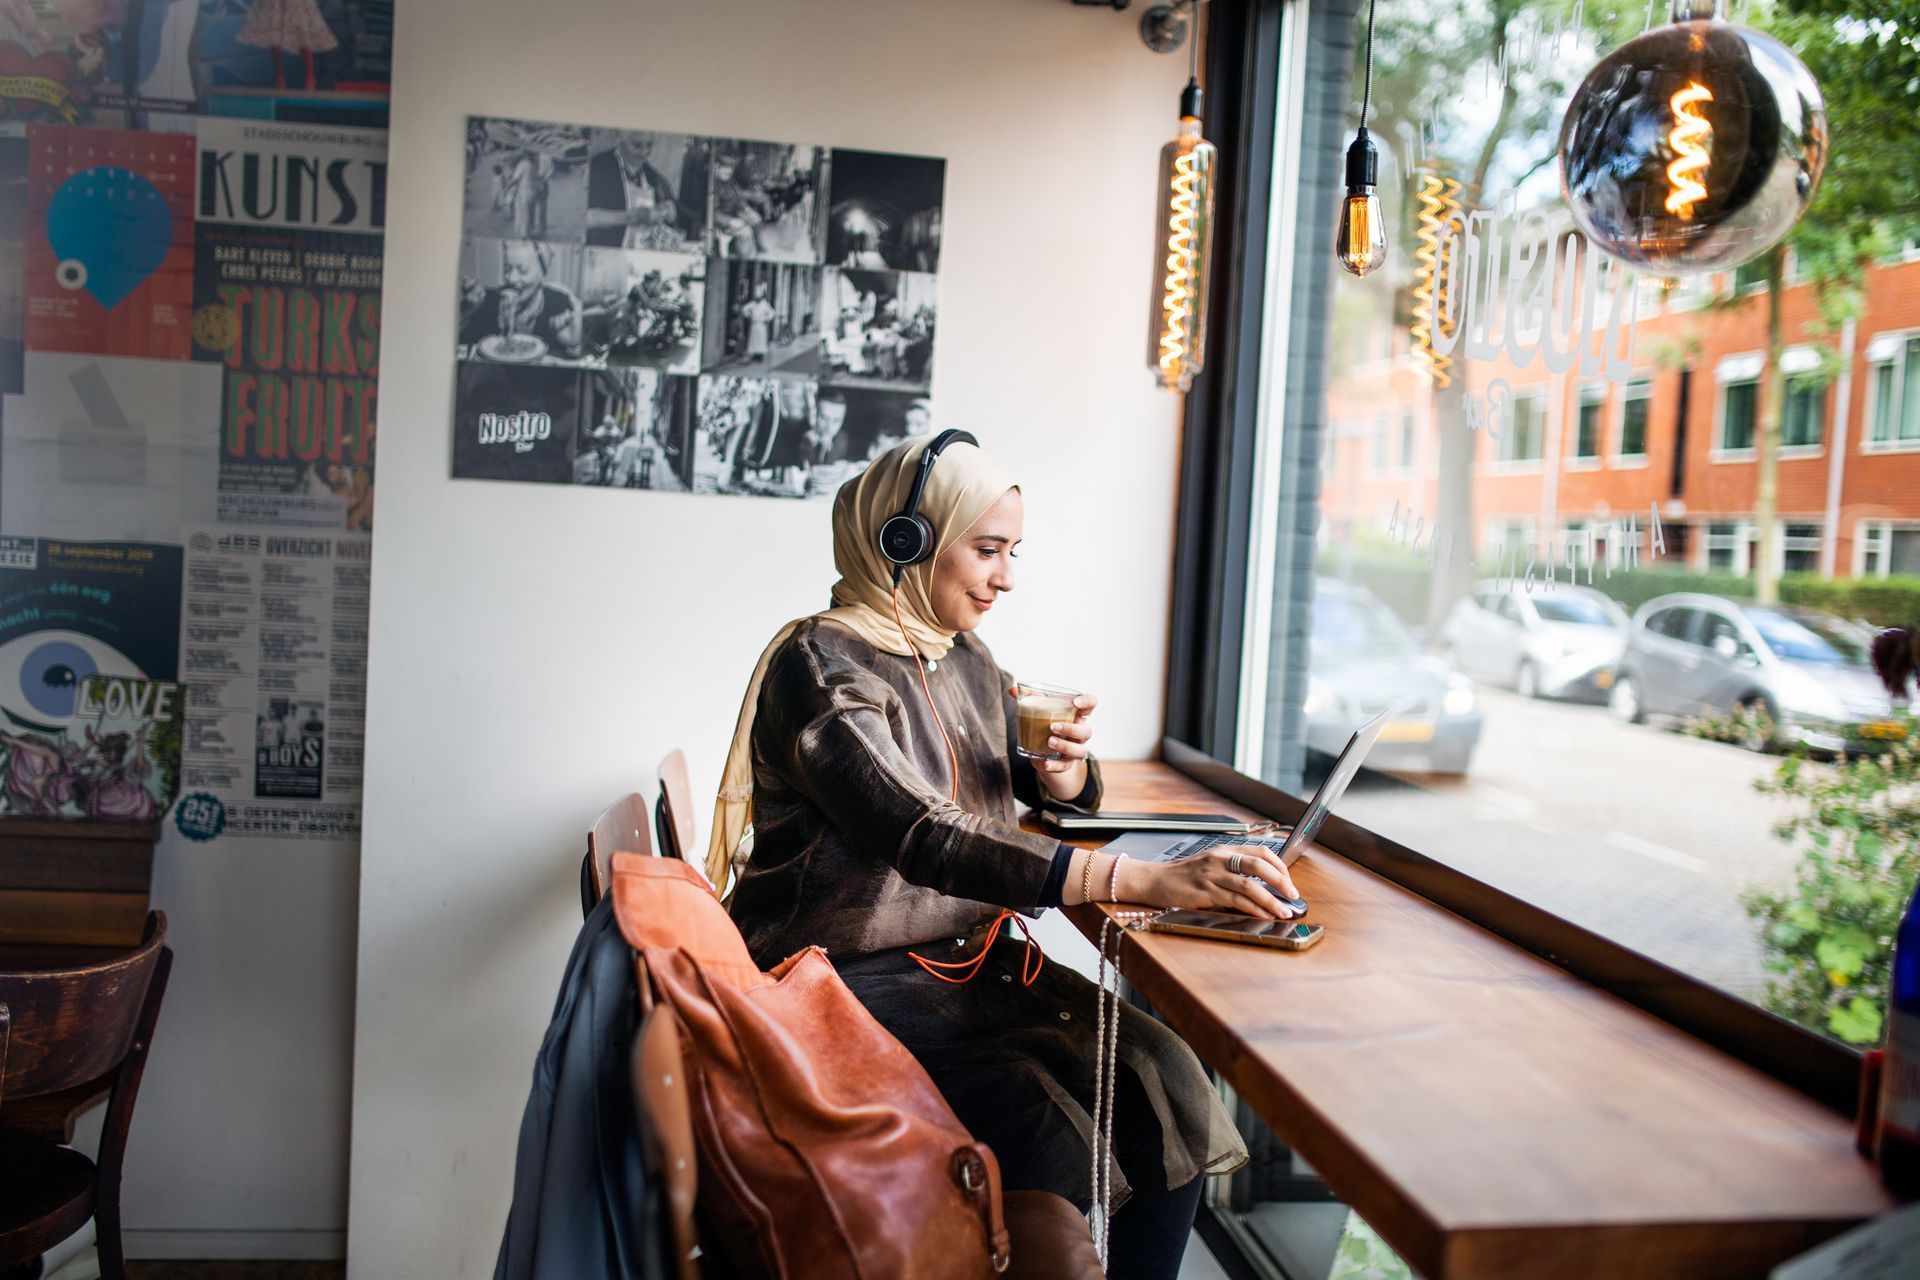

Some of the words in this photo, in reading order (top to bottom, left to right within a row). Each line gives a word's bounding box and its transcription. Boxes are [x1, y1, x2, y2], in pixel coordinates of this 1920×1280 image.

[242, 127, 372, 147] STADSSCHOUWBURG
[200, 149, 386, 227] KUNST
[217, 283, 381, 377] TURKS
[226, 369, 377, 463] FRUIT
[478, 410, 551, 444] Nostro
[64, 545, 125, 560] september
[75, 679, 177, 720] LOVE
